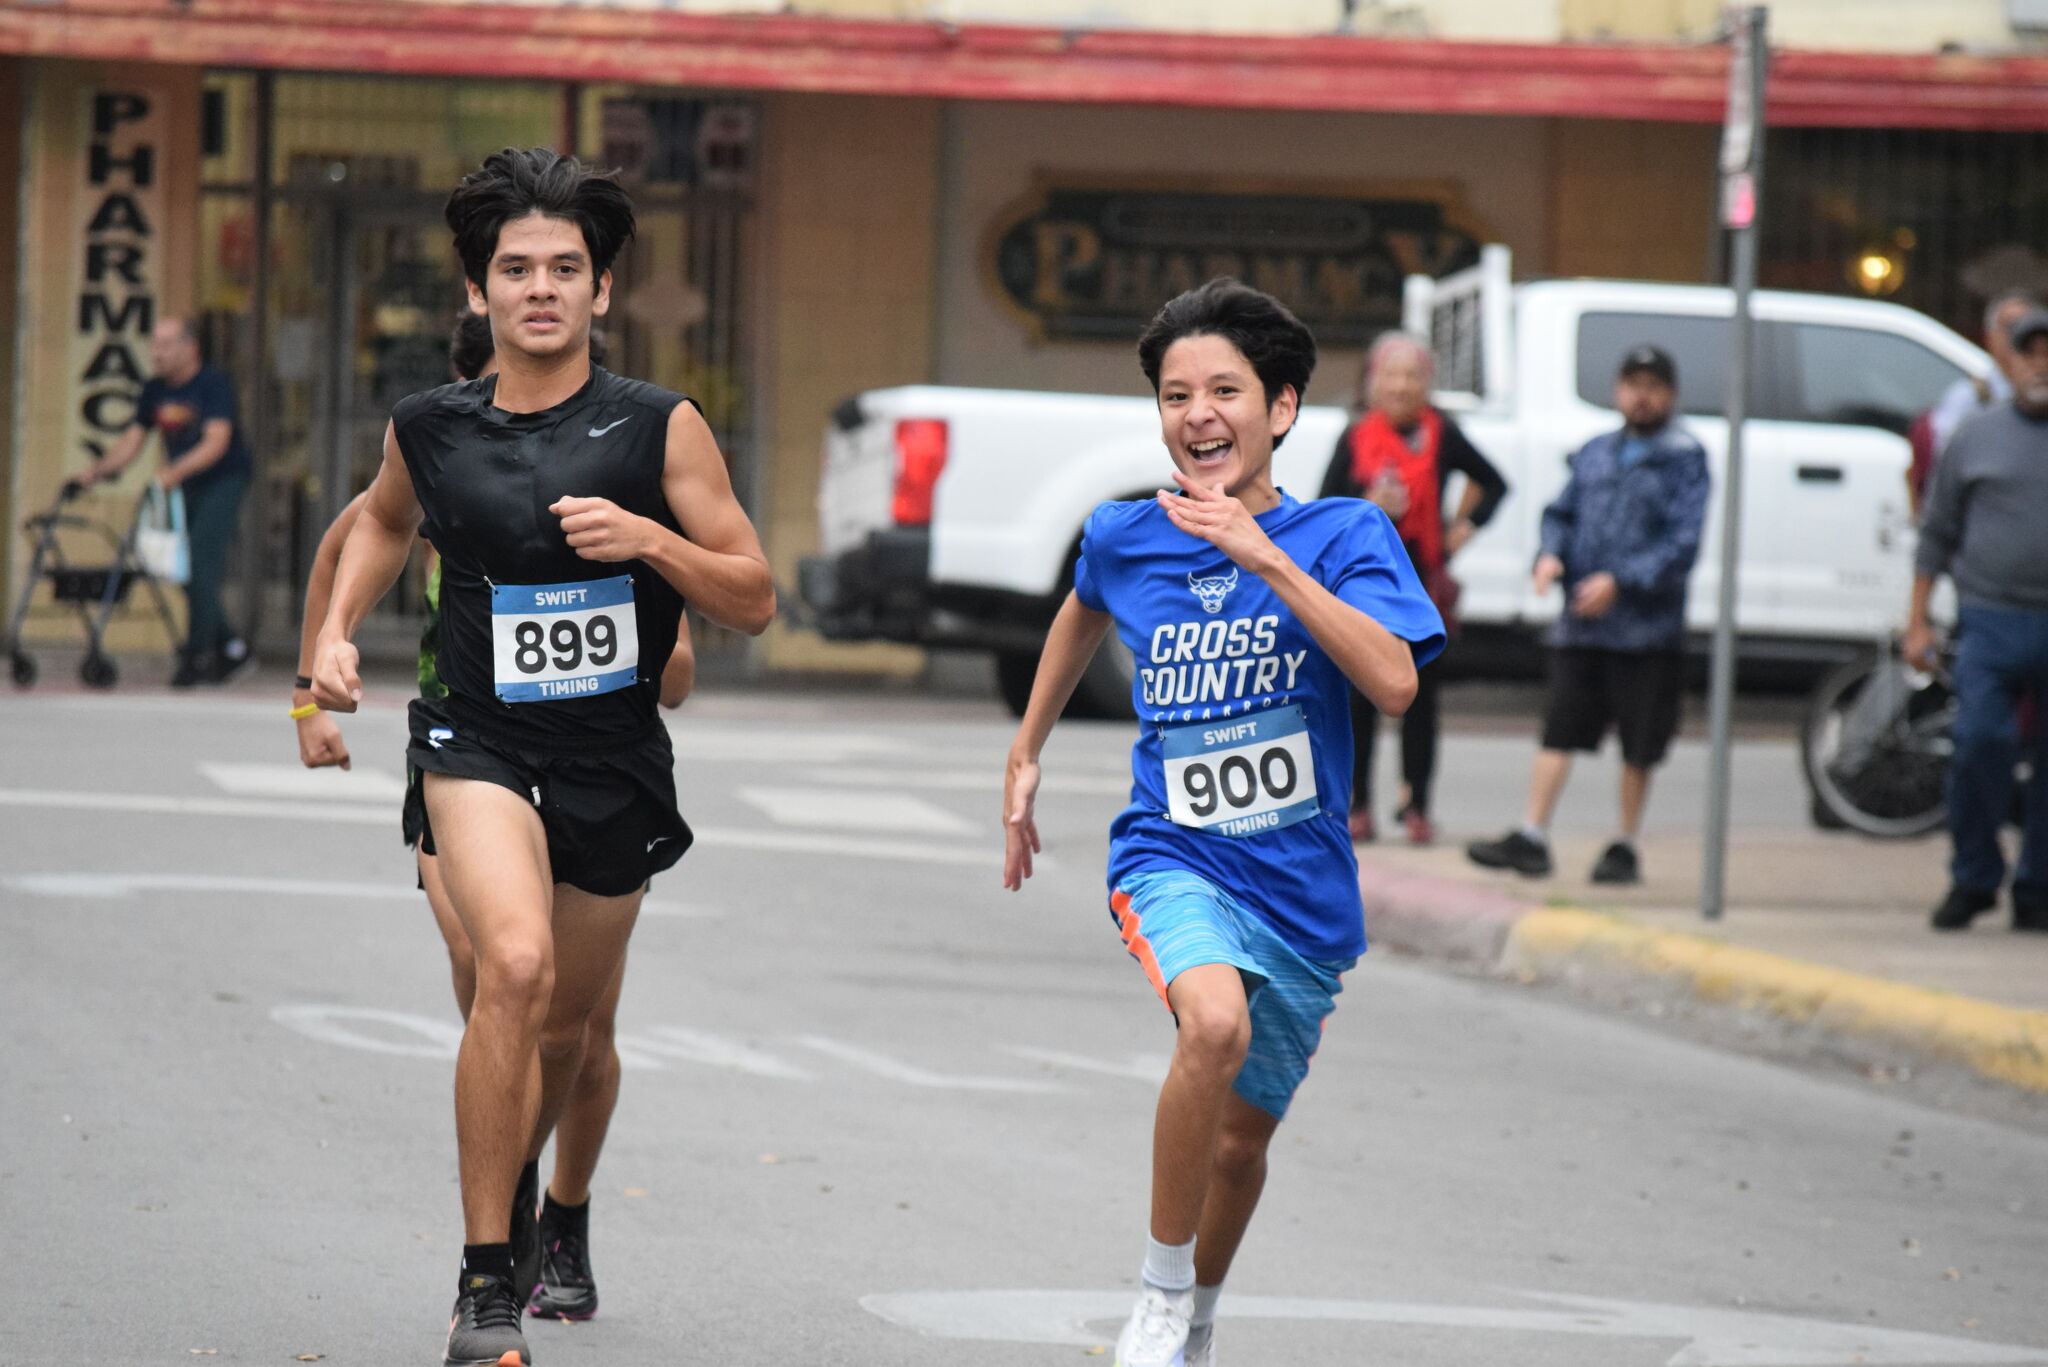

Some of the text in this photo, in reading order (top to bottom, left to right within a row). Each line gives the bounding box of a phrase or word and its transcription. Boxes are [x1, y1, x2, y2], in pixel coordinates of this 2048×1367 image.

[78, 92, 155, 482] PHARMAC
[535, 589, 588, 606] SWIFT
[515, 615, 618, 674] 899
[1151, 615, 1279, 664] CROSS
[539, 677, 599, 697] TIMING
[1140, 650, 1308, 706] COUNTRY
[1203, 721, 1258, 746] SWIFT
[1183, 746, 1298, 818] 900
[1219, 811, 1280, 837] TIMING
